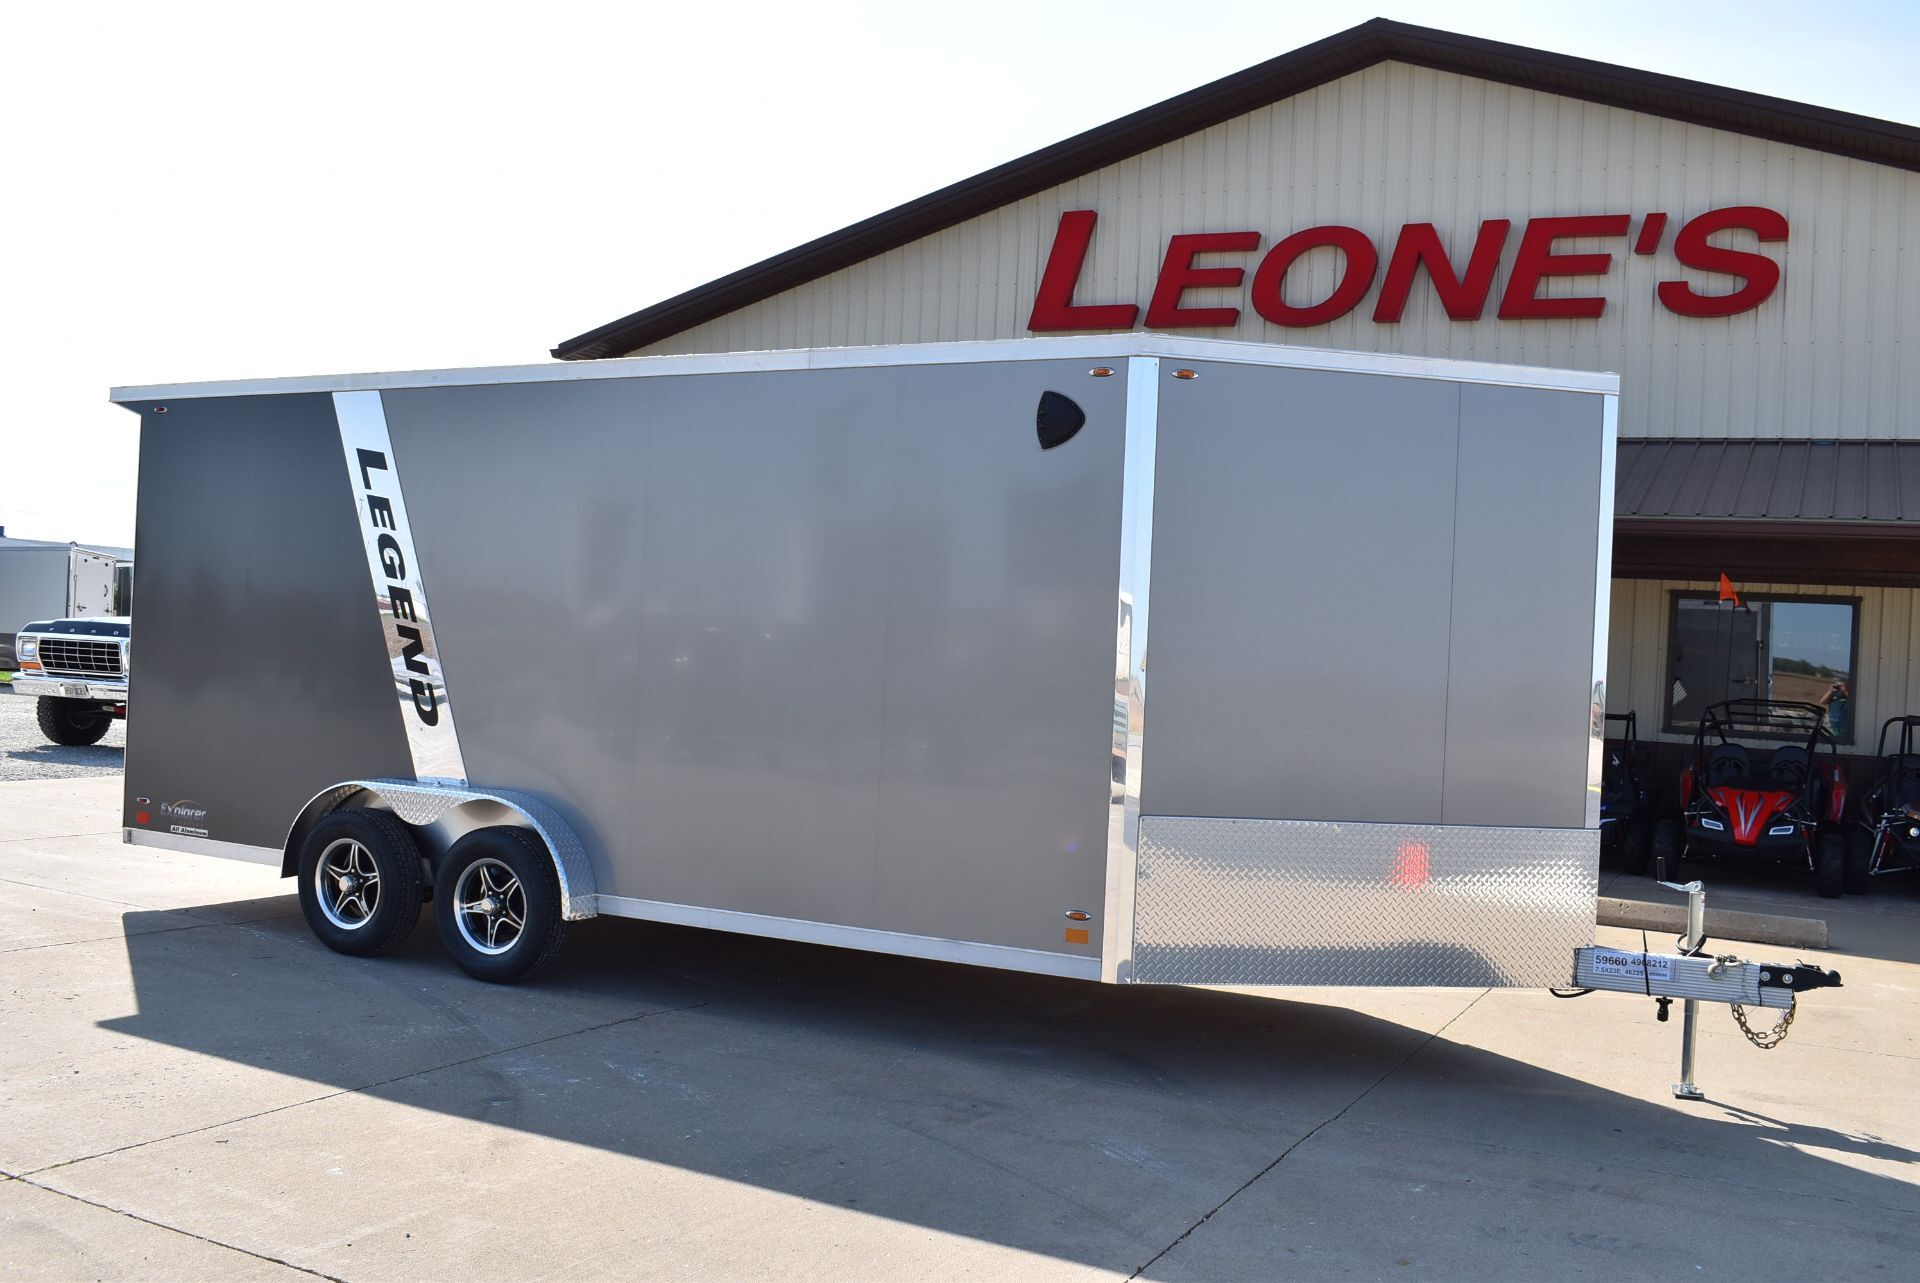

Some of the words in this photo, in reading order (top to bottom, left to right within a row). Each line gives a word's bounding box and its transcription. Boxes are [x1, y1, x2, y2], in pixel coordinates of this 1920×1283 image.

[1027, 205, 1789, 331] LEONE'S
[356, 448, 438, 727] LEGEND
[49, 627, 119, 635] FORD
[1595, 955, 1628, 967] 59660
